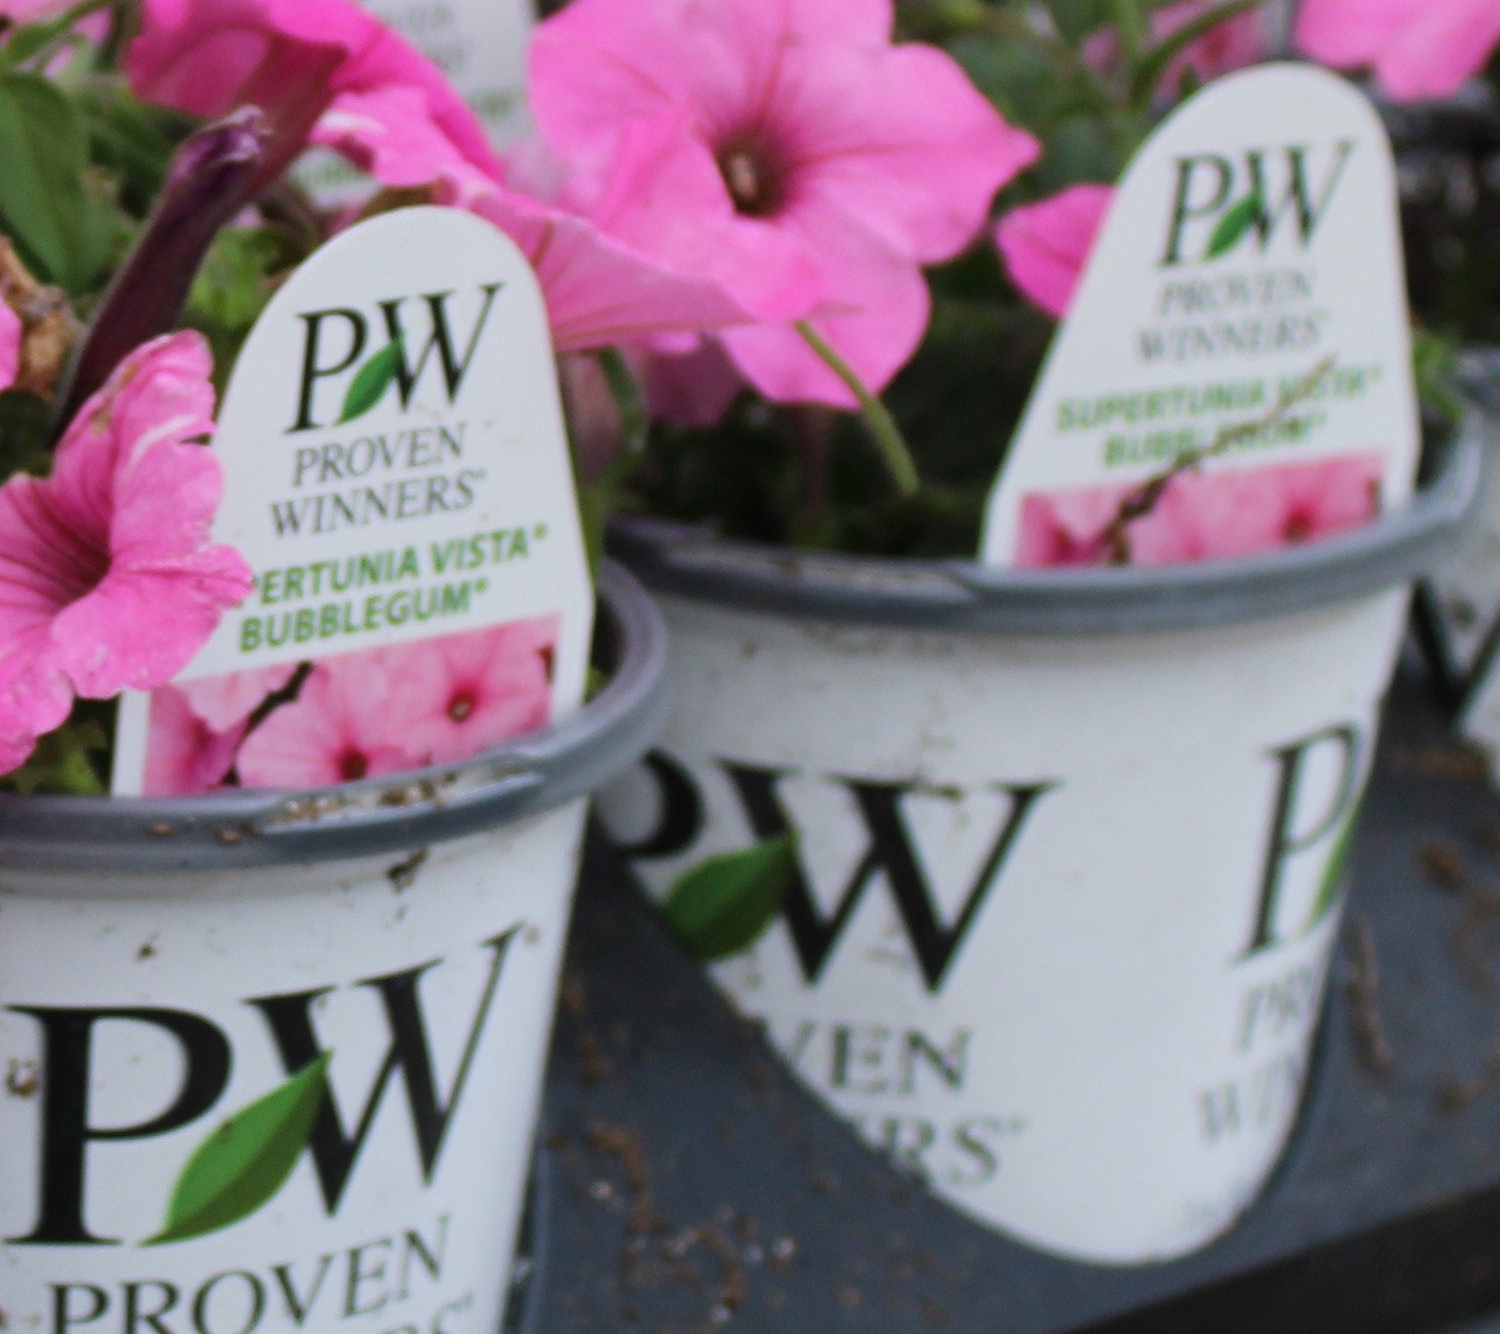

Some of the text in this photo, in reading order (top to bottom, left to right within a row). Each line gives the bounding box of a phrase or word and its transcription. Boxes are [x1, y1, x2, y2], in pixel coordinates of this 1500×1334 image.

[1155, 139, 1357, 270] PW
[282, 282, 506, 435] PW
[290, 421, 468, 489] PROVEN
[253, 544, 420, 606] ERTUNIA
[2, 921, 527, 1247] PW
